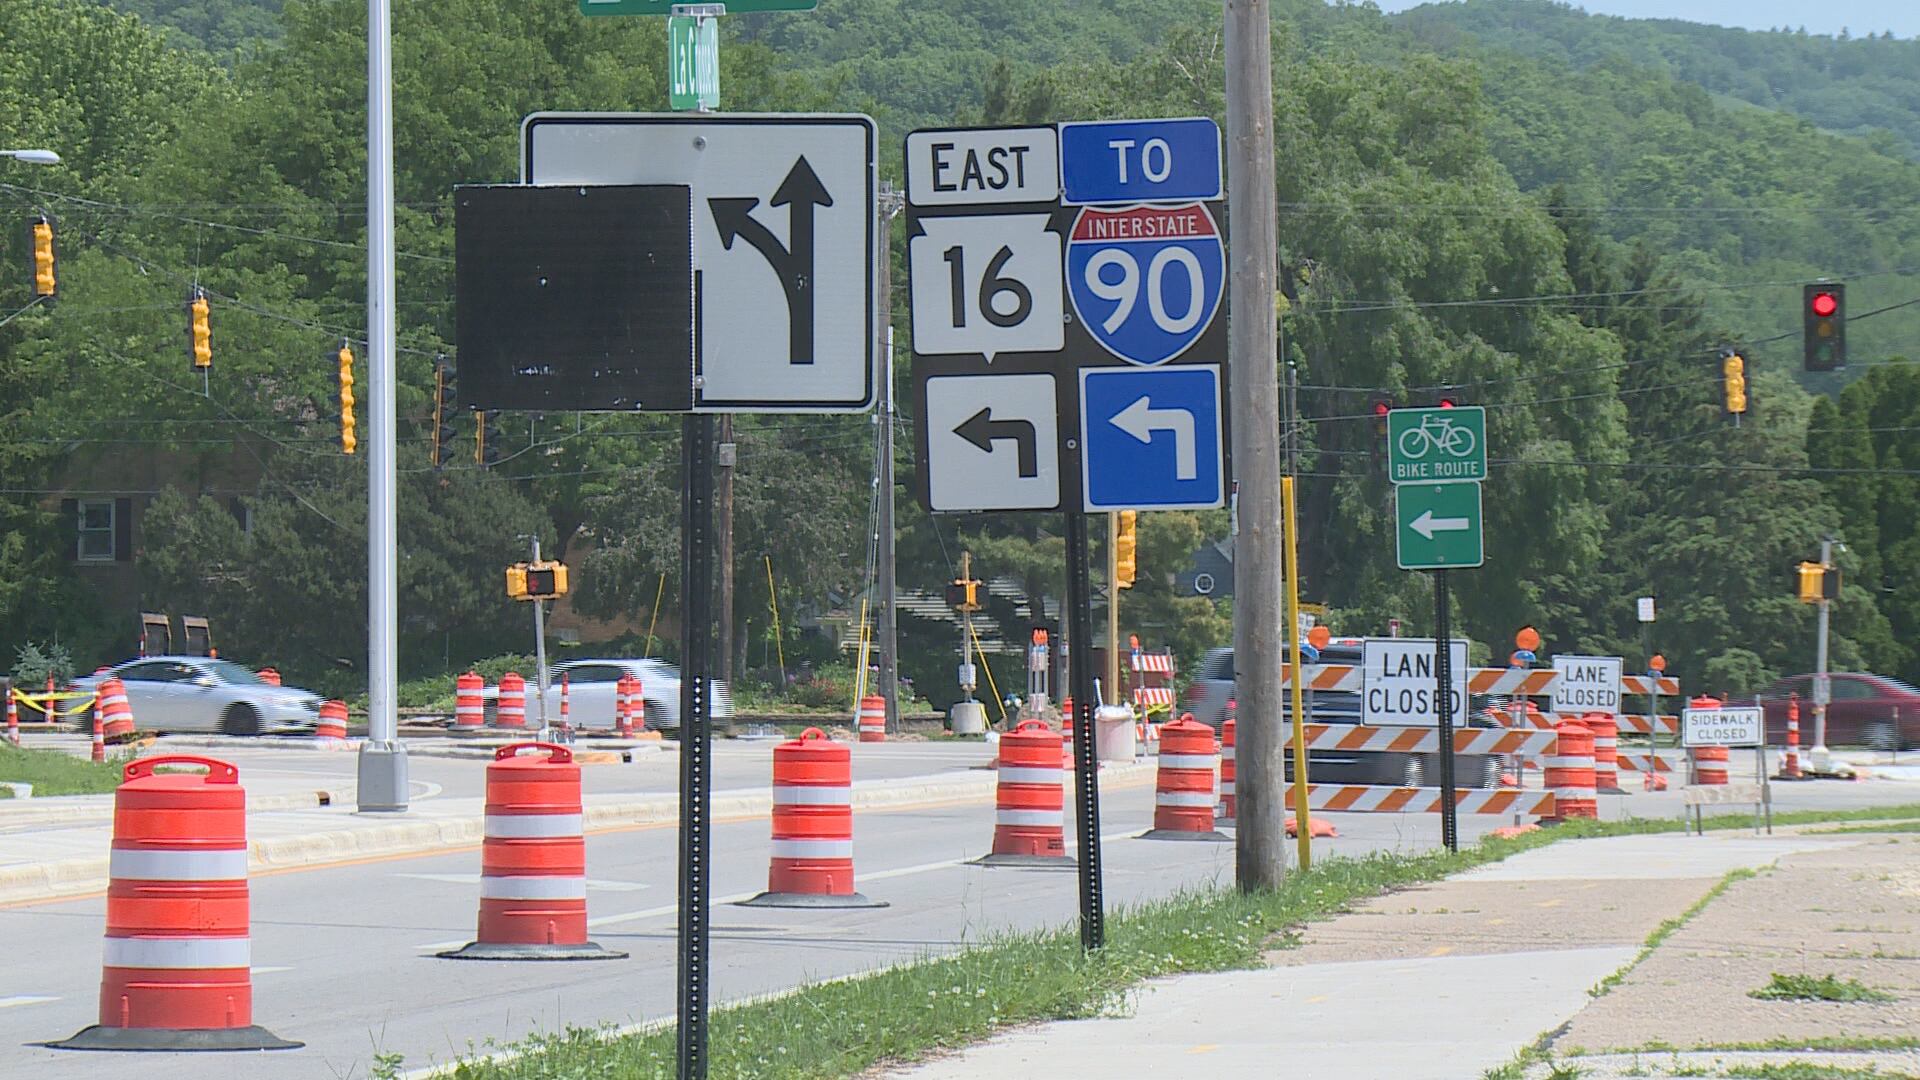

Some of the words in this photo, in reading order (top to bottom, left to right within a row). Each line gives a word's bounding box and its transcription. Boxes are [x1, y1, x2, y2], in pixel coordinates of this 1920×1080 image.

[673, 26, 686, 96] La
[930, 142, 1030, 193] EAST
[1108, 138, 1172, 185] TO
[1088, 214, 1199, 239] INTERSTATE
[943, 244, 1033, 328] 16
[1084, 245, 1205, 336] 90
[1397, 462, 1429, 478] BIKE
[1434, 461, 1479, 476] ROUTE
[1383, 652, 1440, 678] LAN
[1565, 665, 1608, 683] LANE
[1555, 688, 1616, 707] CLOSED
[1691, 714, 1754, 726] SIDEWALK
[1697, 728, 1747, 740] CLOSED
